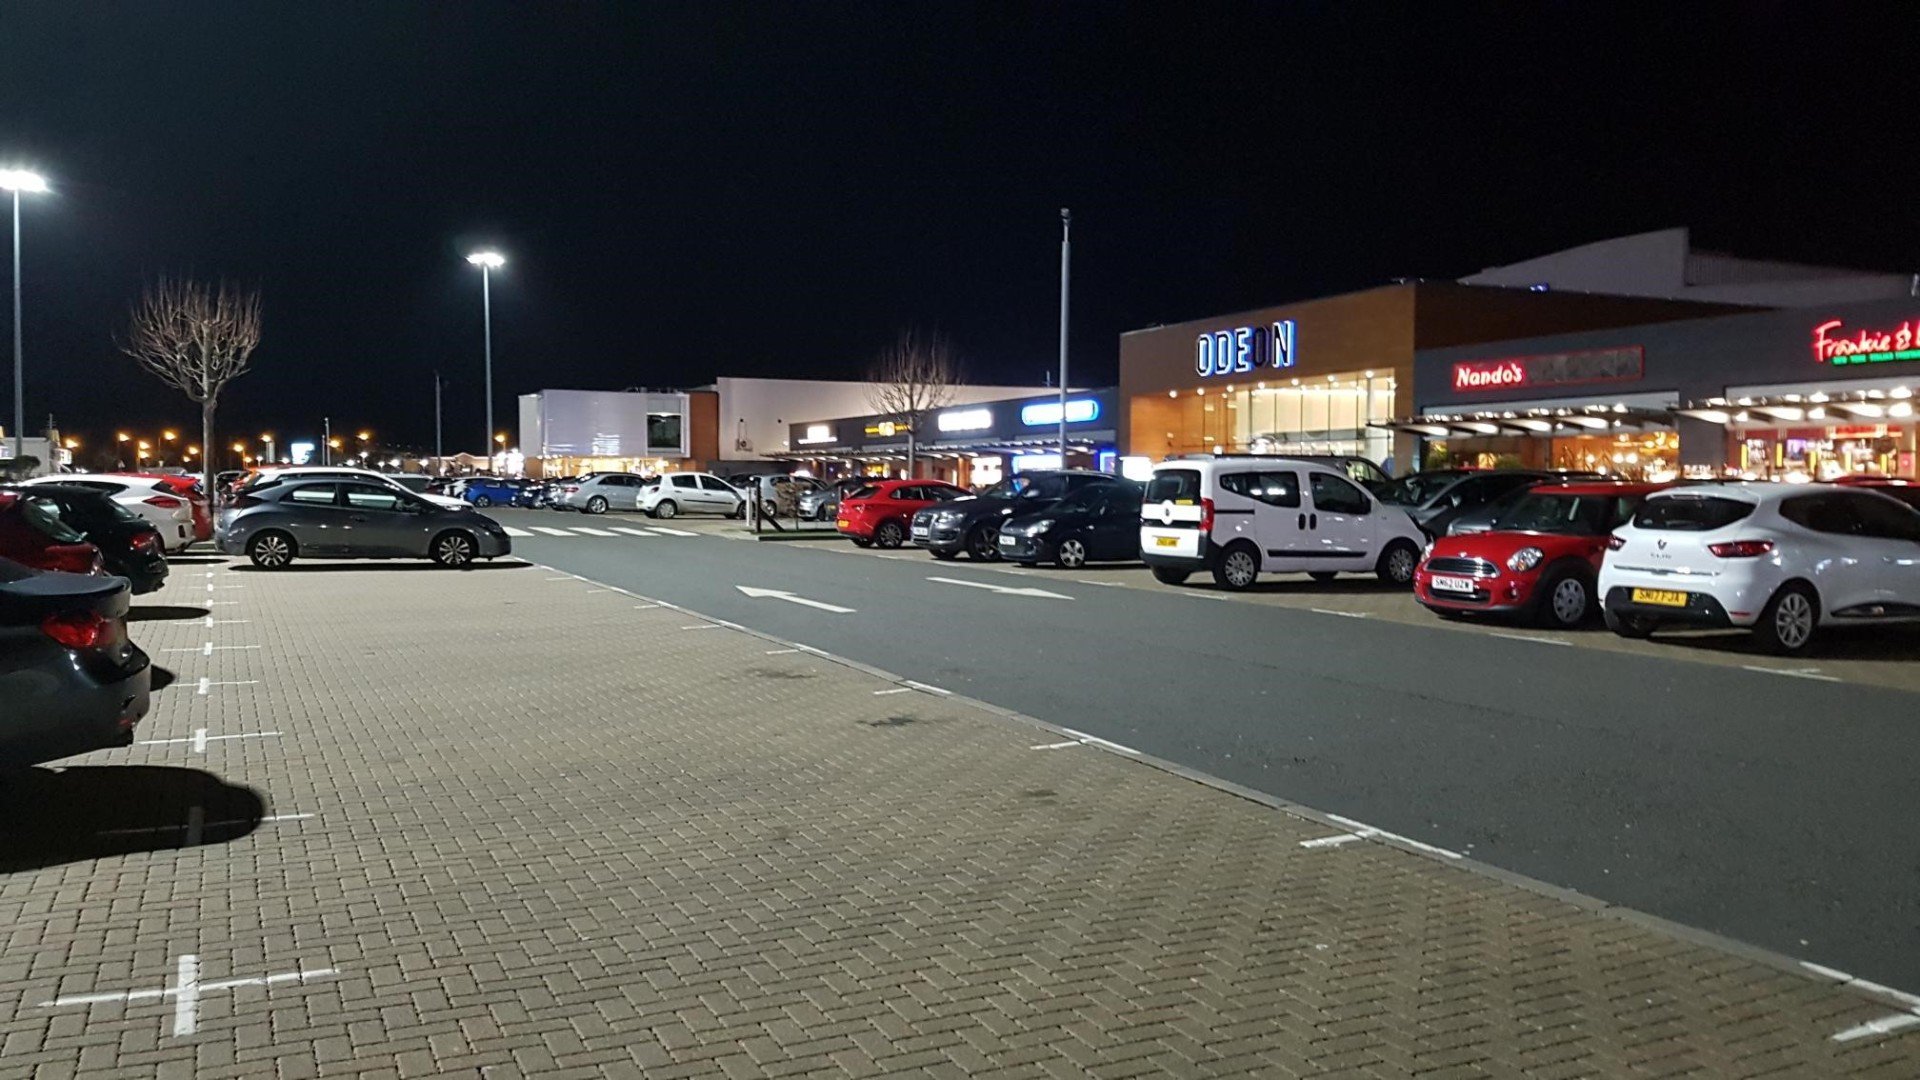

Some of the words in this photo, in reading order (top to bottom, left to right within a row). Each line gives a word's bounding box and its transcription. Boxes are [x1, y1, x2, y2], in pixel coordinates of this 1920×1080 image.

[1196, 320, 1295, 377] ODEON
[1814, 320, 1891, 362] Frankie
[1896, 321, 1912, 351] &
[1456, 363, 1523, 387] Nando's
